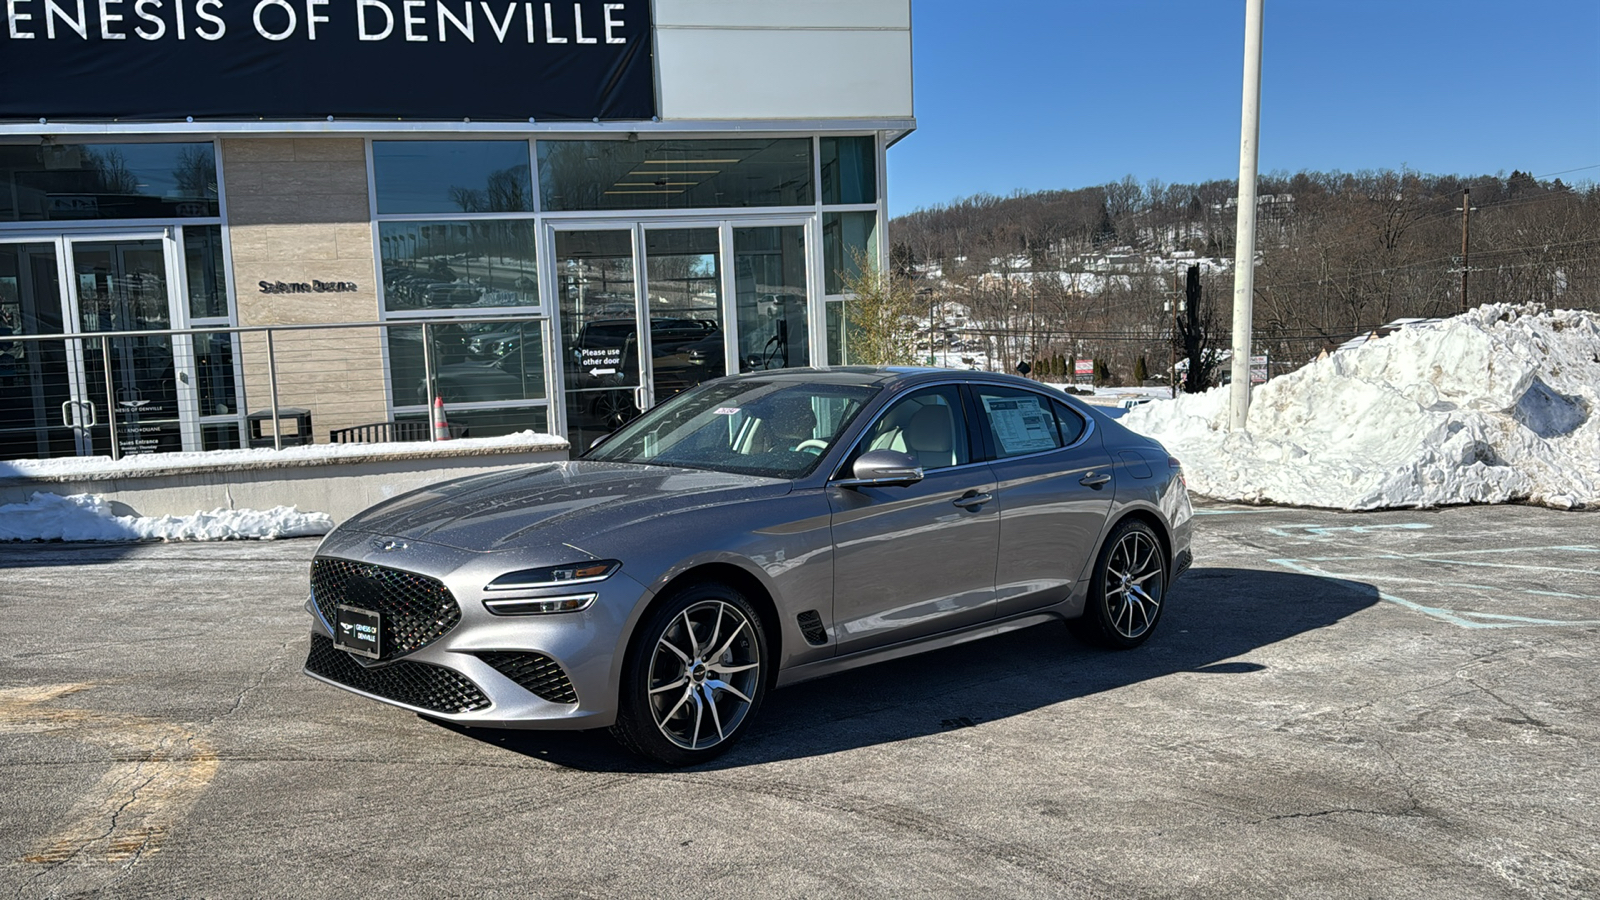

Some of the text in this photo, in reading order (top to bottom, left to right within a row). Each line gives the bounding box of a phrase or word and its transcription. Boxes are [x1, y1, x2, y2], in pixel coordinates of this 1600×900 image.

[252, 0, 330, 41] OF
[356, 0, 627, 44] DENVILLE
[358, 632, 376, 642] DENVILLE
